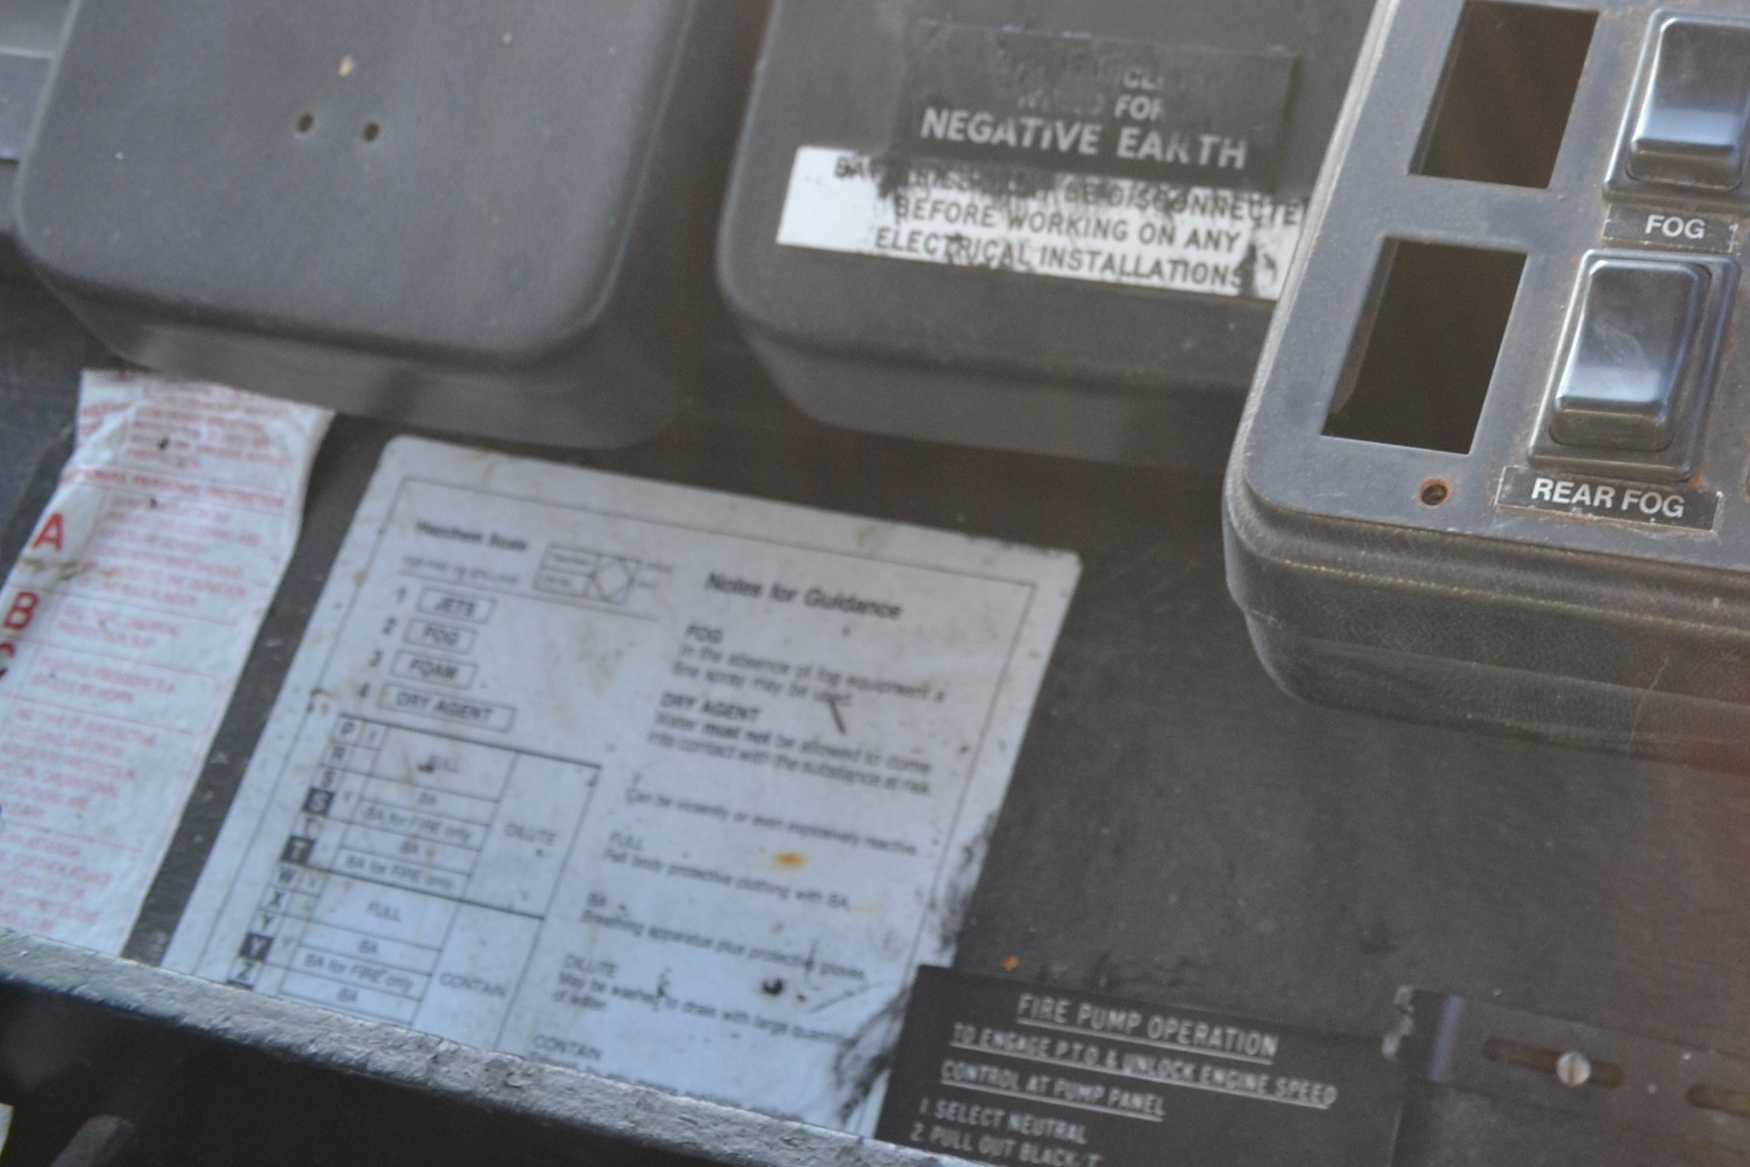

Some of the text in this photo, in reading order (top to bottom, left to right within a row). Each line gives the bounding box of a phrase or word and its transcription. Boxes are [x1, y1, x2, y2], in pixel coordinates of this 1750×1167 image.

[919, 105, 1249, 171] NEGATIVE EARTH
[898, 195, 1242, 254] BEFORE WORKING ON ANY
[1107, 186, 1312, 227] DISCONNECTE
[1644, 213, 1707, 241] FOG
[875, 226, 1246, 288] ELECTRICAL INSTALLATIONS
[1530, 476, 1686, 520] REAR FOG
[31, 512, 65, 553] A
[3, 591, 40, 631] B
[706, 574, 902, 618] Notes for Guidance
[381, 617, 459, 645] 2 FOG
[409, 658, 457, 679] FOAM
[434, 701, 491, 721] AGENT
[310, 792, 328, 810] S
[290, 842, 306, 855] T
[504, 824, 556, 844] DILUTE
[608, 832, 643, 850] FULL
[366, 902, 403, 921] FULL
[349, 965, 384, 982] FIRE
[439, 972, 506, 996] CONTAIN
[1016, 991, 1281, 1059] FIRE PUMP OPERATION
[951, 1021, 977, 1045] TO
[979, 1027, 1053, 1058] ENGAGE
[1122, 1050, 1197, 1084] UNLOCK
[1201, 1064, 1271, 1096] ENGINE
[1272, 1076, 1339, 1108] SPEED
[941, 1059, 1168, 1119] CONTROL AT PUMP PANEL
[933, 1098, 1005, 1129] SELECT
[1007, 1112, 1089, 1146] NEUTRAL
